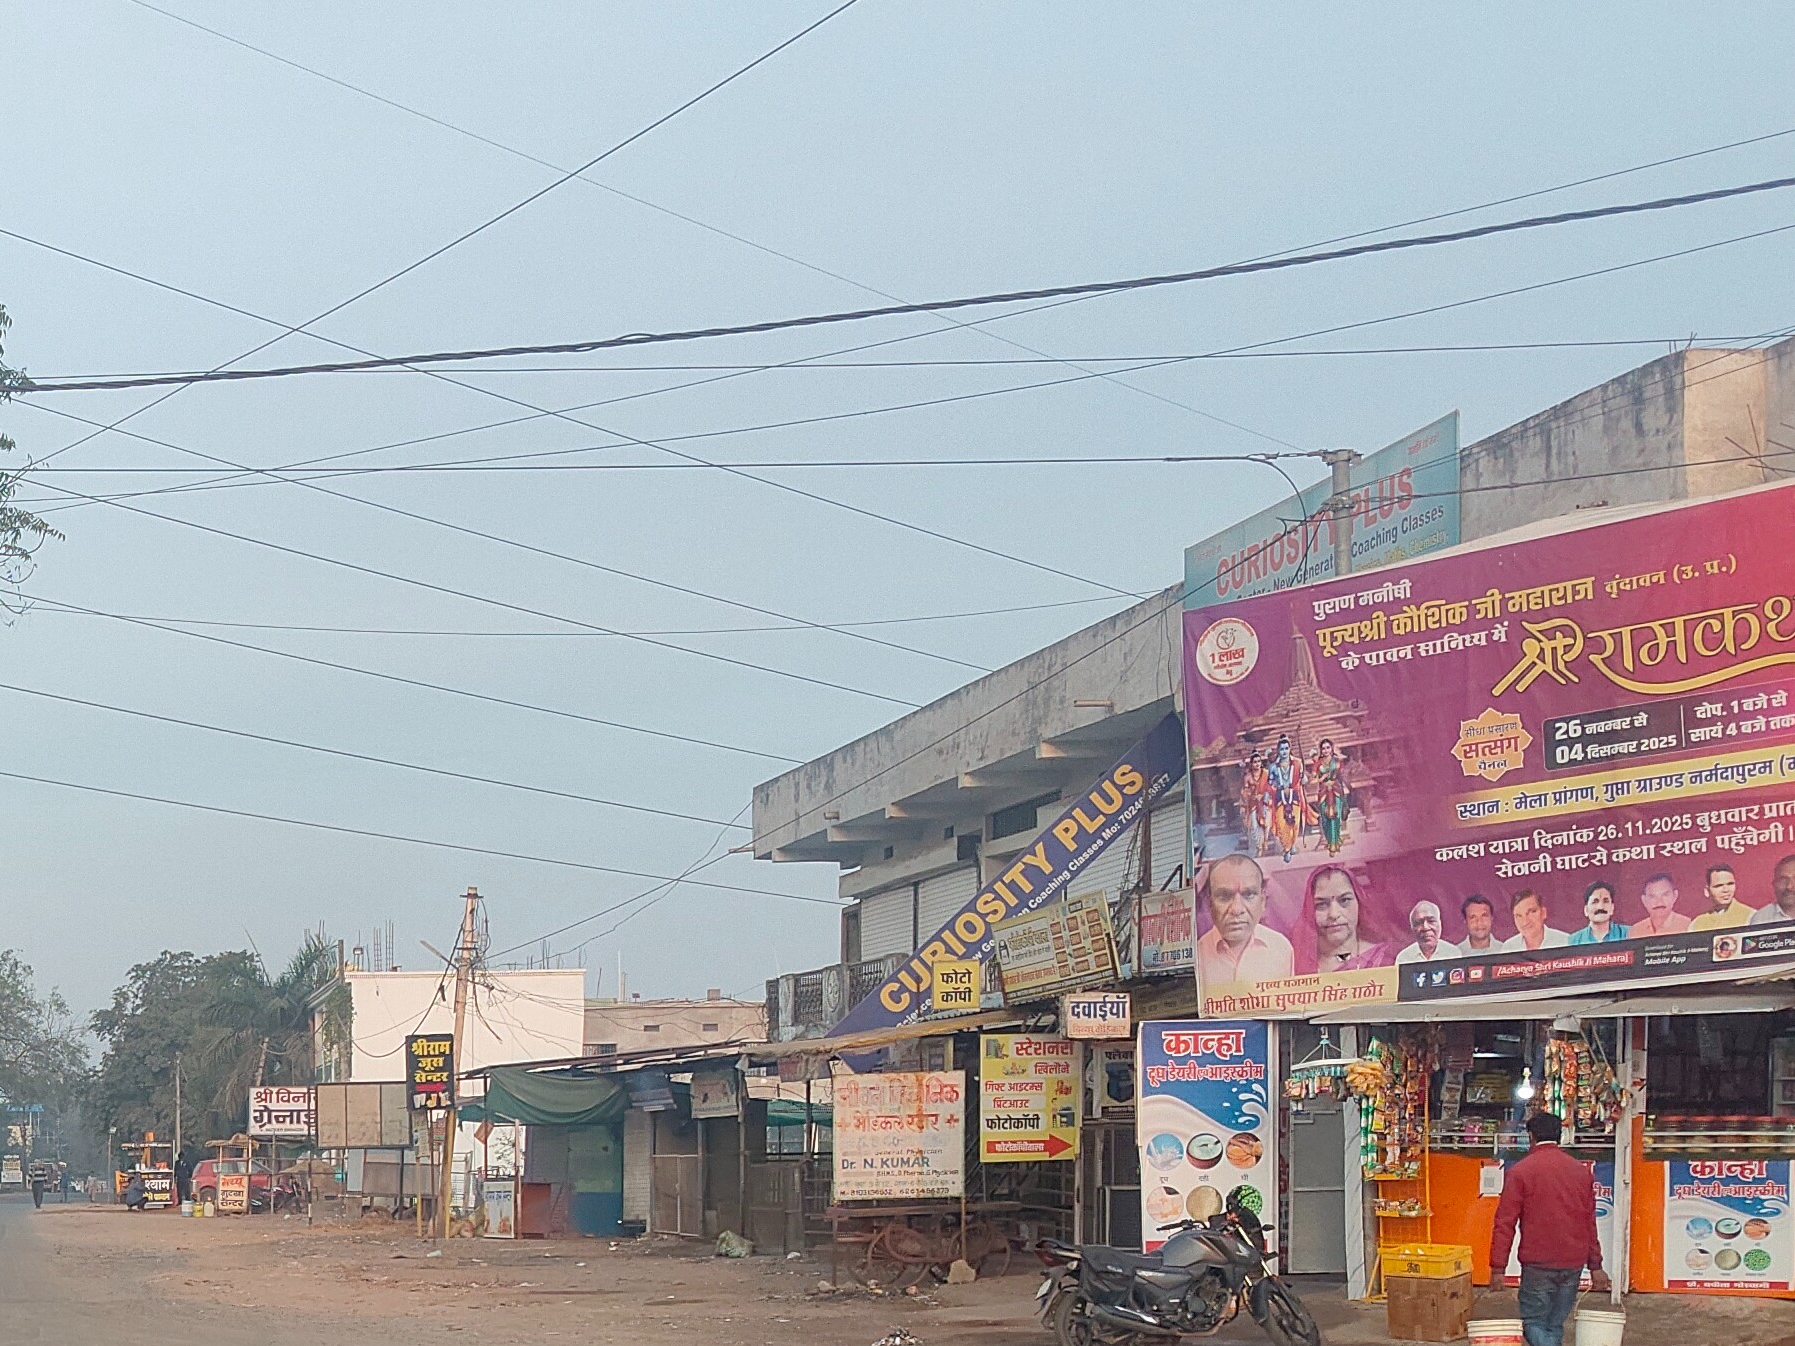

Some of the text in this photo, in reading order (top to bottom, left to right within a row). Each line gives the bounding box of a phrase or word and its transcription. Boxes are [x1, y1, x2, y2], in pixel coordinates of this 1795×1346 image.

[1216, 467, 1414, 597] CURIOSITY PLUS
[1296, 552, 1336, 585] Generat
[1351, 528, 1398, 558] Coaching
[1401, 504, 1444, 536] Classes
[1313, 579, 1412, 621] पुराण मनीषी
[1316, 611, 1387, 657] पूज्यश्री
[1391, 599, 1467, 637] कौशिक
[1473, 588, 1503, 621] जी
[1505, 576, 1595, 614] महाराज
[1604, 571, 1667, 598] वृंदावन
[1218, 647, 1245, 662] लाख
[1339, 621, 1509, 671] के पावन सानिध्य में
[1585, 595, 1795, 694] रामकथ
[1694, 690, 1788, 720] दोप. 1 बजे से
[1554, 711, 1648, 741] 26 नवम्बर से
[1689, 721, 1724, 743] सायं
[1725, 721, 1738, 738] 4
[1740, 716, 1768, 736] बजे
[1461, 732, 1521, 760] सत्संग
[1556, 734, 1677, 765] 04 दिसम्बर 2025
[1477, 757, 1508, 772] चैनल
[1456, 801, 1499, 820] स्थान
[1513, 790, 1548, 811] मेला
[1635, 770, 1684, 793] ग्राउण्ड
[1688, 756, 1773, 786] नर्मदापुरम
[1435, 843, 1485, 863] कलश
[1488, 835, 1529, 854] यात्रा
[1532, 824, 1595, 849] दिनांक
[1597, 813, 1692, 841] 26.11.2025
[1695, 801, 1761, 833] बुधवार
[1495, 853, 1551, 879] सेठानी
[1611, 842, 1655, 863] कथा
[1659, 837, 1707, 858] स्थल
[1715, 824, 1784, 855] पहुँचेगी
[1028, 822, 1122, 910] Coaching Classes Mo:
[879, 840, 1054, 1013] CURIOSITY
[1052, 763, 1143, 853] PLUS
[1758, 940, 1783, 950] Google
[1552, 959, 1583, 971] Kaushik
[1645, 955, 1686, 966] Mobile App
[940, 968, 973, 984] फोटो
[940, 987, 974, 1003] कॉपी
[1240, 992, 1270, 1012] शोभा
[1321, 982, 1348, 1002] सिंह
[1351, 980, 1385, 1000] राठौर
[411, 1038, 451, 1056] श्रीराम
[1162, 1030, 1245, 1061] कान्हा
[414, 1071, 449, 1083] सेन्टर
[418, 1057, 445, 1071] जूस
[1034, 1061, 1070, 1075] खिलौने
[1147, 1065, 1167, 1087] दूध
[1167, 1060, 1198, 1082] डेयरी
[254, 1088, 273, 1104] श्री
[985, 1081, 1044, 1093] गिफ्ट आइटम्स
[993, 1096, 1030, 1109] प्रिंटआउट
[986, 1114, 1041, 1130] फोटोकॉपी
[842, 1157, 930, 1169] Dr. N. KUMAR
[1674, 1184, 1692, 1199] दूध
[1693, 1180, 1721, 1198] डेयरी
